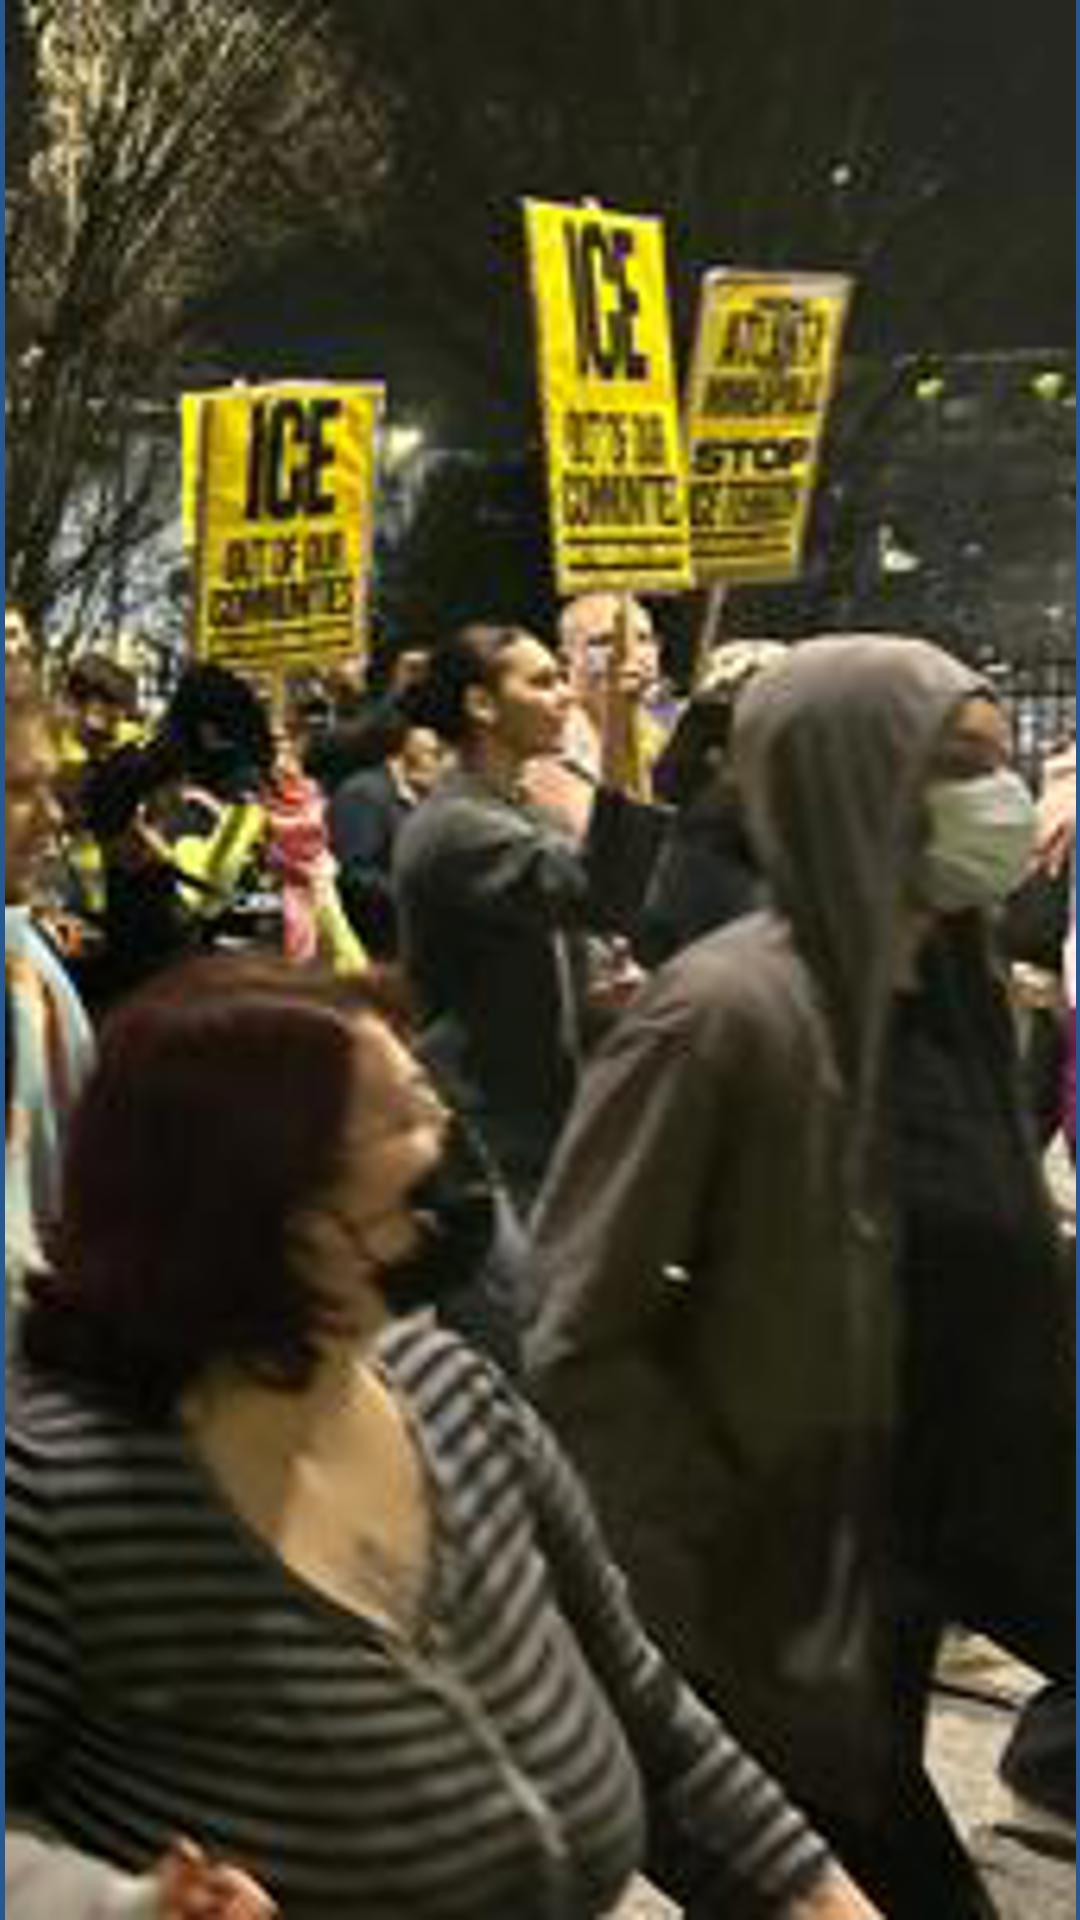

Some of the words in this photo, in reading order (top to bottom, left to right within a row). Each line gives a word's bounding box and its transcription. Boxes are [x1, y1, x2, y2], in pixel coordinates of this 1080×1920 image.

[563, 217, 648, 382] ICE
[246, 398, 342, 520] ICE
[692, 437, 808, 477] STOP
[224, 536, 264, 584] OUT
[270, 534, 299, 578] OF
[304, 528, 347, 573] OUR
